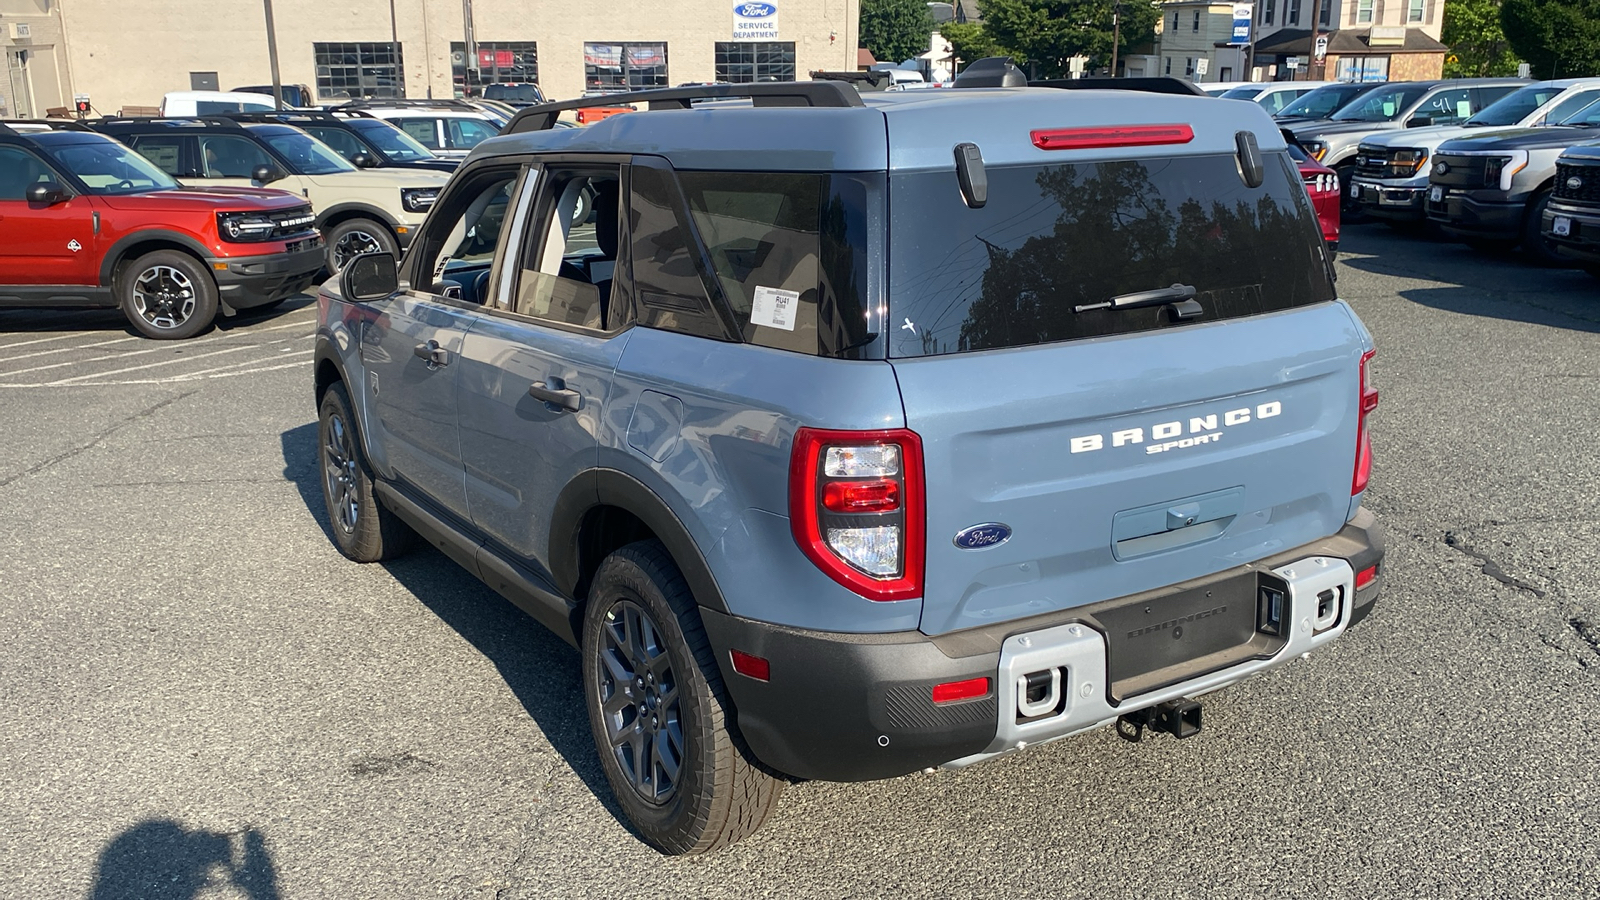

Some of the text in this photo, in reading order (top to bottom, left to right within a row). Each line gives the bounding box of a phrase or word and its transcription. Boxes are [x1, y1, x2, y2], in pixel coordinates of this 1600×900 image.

[742, 3, 769, 16] Ford
[733, 31, 779, 39] DEPARTMENT
[1070, 401, 1281, 453] BRONCO
[1146, 432, 1223, 455] SPORT
[1127, 605, 1227, 640] BRONCO
